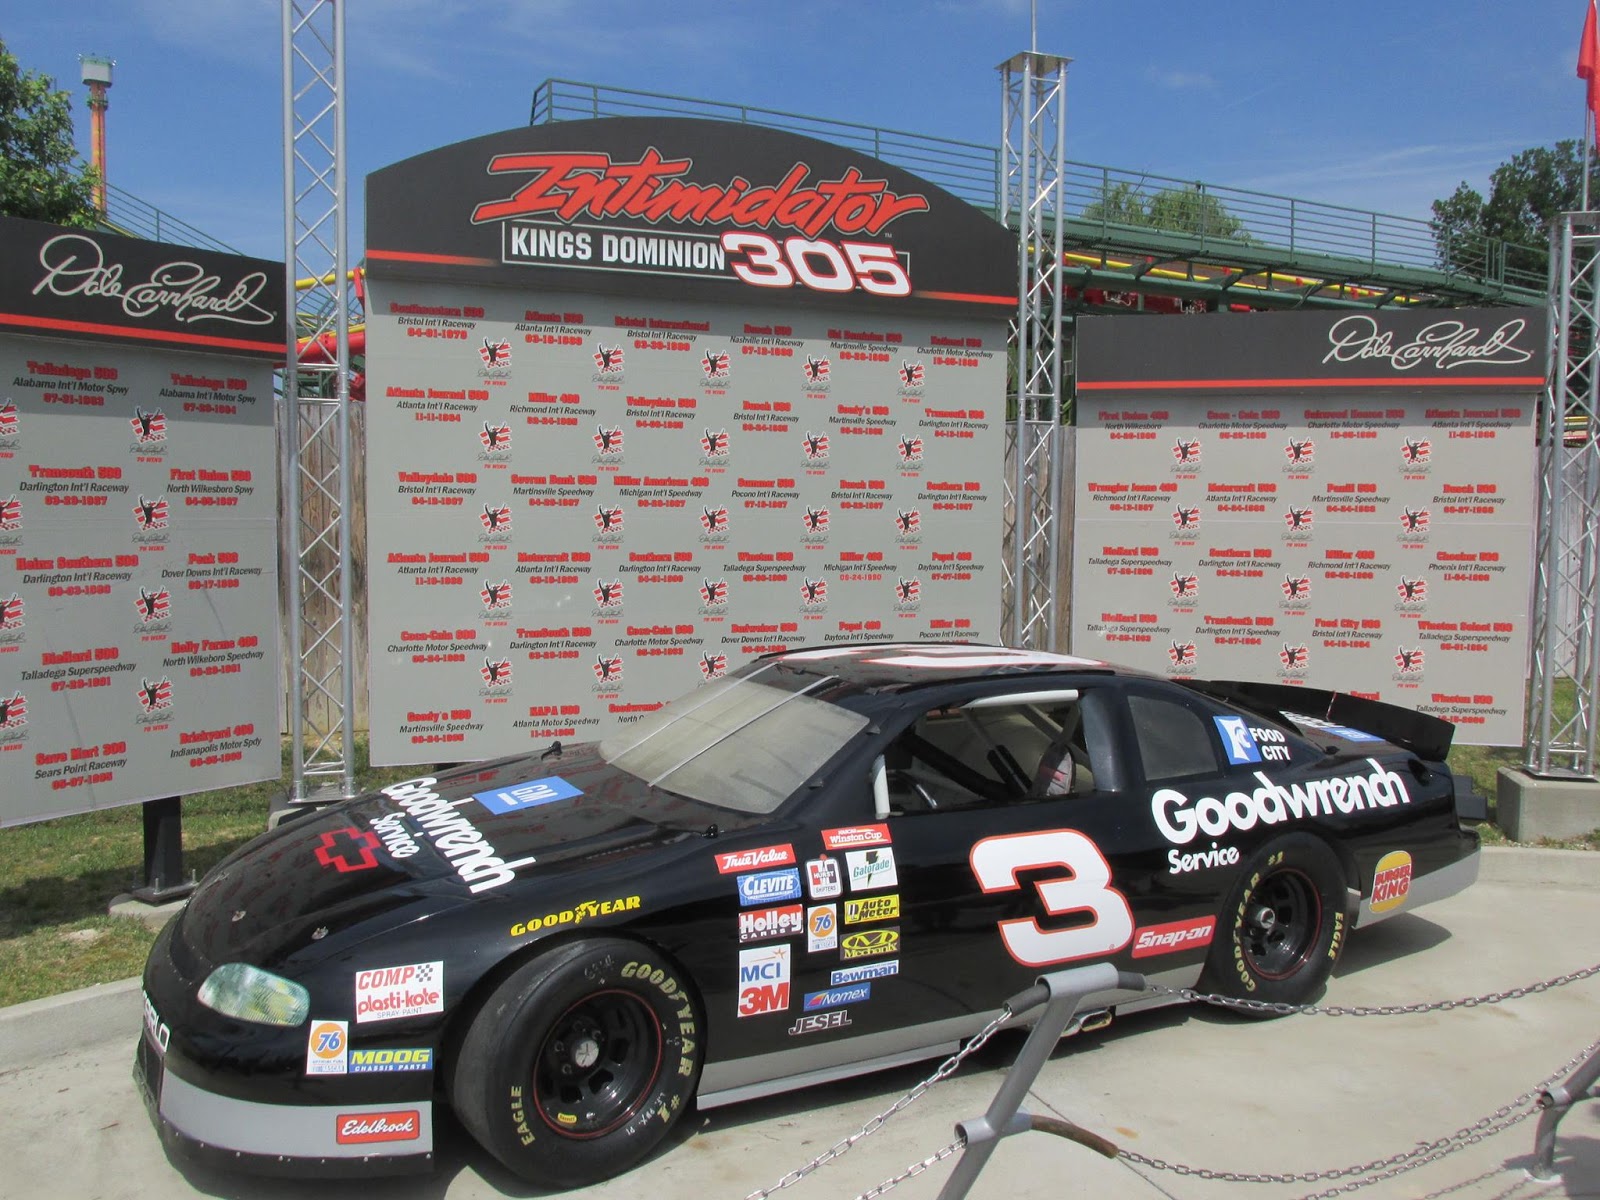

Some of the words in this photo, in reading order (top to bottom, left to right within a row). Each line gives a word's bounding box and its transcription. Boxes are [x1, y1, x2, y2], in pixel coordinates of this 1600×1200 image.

[470, 146, 930, 240] Intimidator
[511, 227, 592, 260] KINGS
[602, 234, 726, 271] DOMINION
[720, 231, 912, 297] 305
[32, 234, 124, 296] Dale
[122, 261, 274, 325] Earnhardt
[398, 316, 423, 325] Bristol
[426, 318, 442, 326] Int'l
[443, 320, 475, 329] Raceway
[1322, 315, 1394, 364] Dale
[1391, 319, 1532, 370] Earnhardt
[397, 400, 425, 410] Atlanta
[427, 401, 444, 410] Int'l
[445, 403, 478, 412] Raceway
[510, 404, 547, 414] Richmond
[549, 406, 564, 415] Int'l
[565, 407, 596, 416] Raceway
[829, 415, 864, 425] Martinsville
[867, 418, 896, 427] Speedway
[20, 482, 68, 493] Darlington
[71, 482, 88, 492] Int'l
[91, 483, 129, 494] Raceway
[167, 483, 189, 493] North
[192, 484, 232, 494] Wilkesboro
[235, 486, 254, 495] Spwy
[513, 486, 556, 496] Martinsville
[558, 488, 594, 497] Speedway
[732, 489, 756, 498] Pocono
[757, 490, 770, 498] Int'l
[771, 490, 800, 500] Raceway
[162, 569, 184, 579] Dover
[186, 568, 211, 578] Downs
[213, 567, 228, 576] Int'l
[230, 566, 262, 576] Raceway
[724, 564, 754, 574] Talladega
[756, 564, 806, 573] Superspeedway
[1308, 560, 1343, 569] Richmond
[1360, 562, 1390, 571] Raceway
[1429, 562, 1456, 571] Phoenix
[1474, 564, 1506, 573] Raceway
[23, 575, 71, 585] Darlington
[74, 572, 91, 582] Int'l
[94, 572, 132, 581] Raceway
[1312, 629, 1335, 638] Bristol
[1352, 630, 1382, 640] Raceway
[1419, 632, 1452, 642] Talladega
[1455, 634, 1510, 643] Superspeedway
[388, 644, 423, 653] Charlotte
[426, 643, 448, 652] Motor
[450, 643, 487, 652] Speedway
[510, 641, 548, 651] Darlington
[550, 640, 565, 648] Int'l
[566, 640, 597, 649] Raceway
[163, 657, 185, 667] North
[188, 655, 225, 664] Wilkeboro
[227, 651, 264, 662] Speedway
[22, 670, 65, 680] Talladega
[68, 663, 136, 676] Superspeedway
[400, 724, 444, 733] Martinsville
[447, 723, 483, 732] Speedway
[513, 719, 539, 728] Atlanta
[541, 719, 562, 727] Motor
[565, 718, 600, 727] Speedway
[1250, 727, 1286, 744] FOOD
[171, 745, 217, 758] Indianapolis
[220, 741, 243, 750] Motor
[244, 737, 261, 748] Spdy
[1262, 745, 1291, 761] CITY
[35, 769, 61, 779] Sears
[64, 765, 86, 774] Point
[89, 759, 127, 770] Raceway
[1151, 758, 1411, 844] Goodwrench
[370, 812, 420, 858] Service
[381, 777, 537, 893] Goodwrench
[829, 832, 864, 844] Winston
[864, 831, 883, 841] Cup
[1167, 841, 1240, 875] Service
[814, 870, 835, 879] HURST
[853, 857, 890, 878] Gatorade
[1375, 863, 1411, 883] BURGER
[744, 873, 795, 896] CLEVITE
[815, 885, 836, 894] SHIFTERS
[1371, 876, 1410, 904] KING
[861, 898, 891, 910] Auto
[969, 828, 1135, 967] 3
[510, 895, 641, 937] GOODYEAR
[858, 905, 897, 921] Meter
[739, 910, 801, 934] Holley
[815, 915, 832, 932] 76
[741, 928, 786, 940] CARBS
[1135, 925, 1212, 950] Snap-on
[1328, 912, 1344, 960] EAGLE
[844, 942, 898, 959] Mechanix
[358, 966, 415, 990] COMP
[741, 962, 781, 982] MCI
[831, 964, 897, 985] Bowman
[358, 988, 439, 1015] plasti-kote
[739, 982, 789, 1015] 3M
[822, 987, 869, 1006] Nomex
[377, 1010, 400, 1019] SPRAY
[402, 1007, 423, 1016] PAINT
[621, 961, 696, 1077] GOODYEAR
[788, 1009, 852, 1036] JESEL
[316, 1031, 341, 1052] 76
[351, 1050, 430, 1064] MOOG
[354, 1063, 394, 1072] CHASSIS
[399, 1062, 426, 1071] PARTS
[511, 1085, 535, 1146] EAGLE
[341, 1116, 415, 1137] Edelbrock
